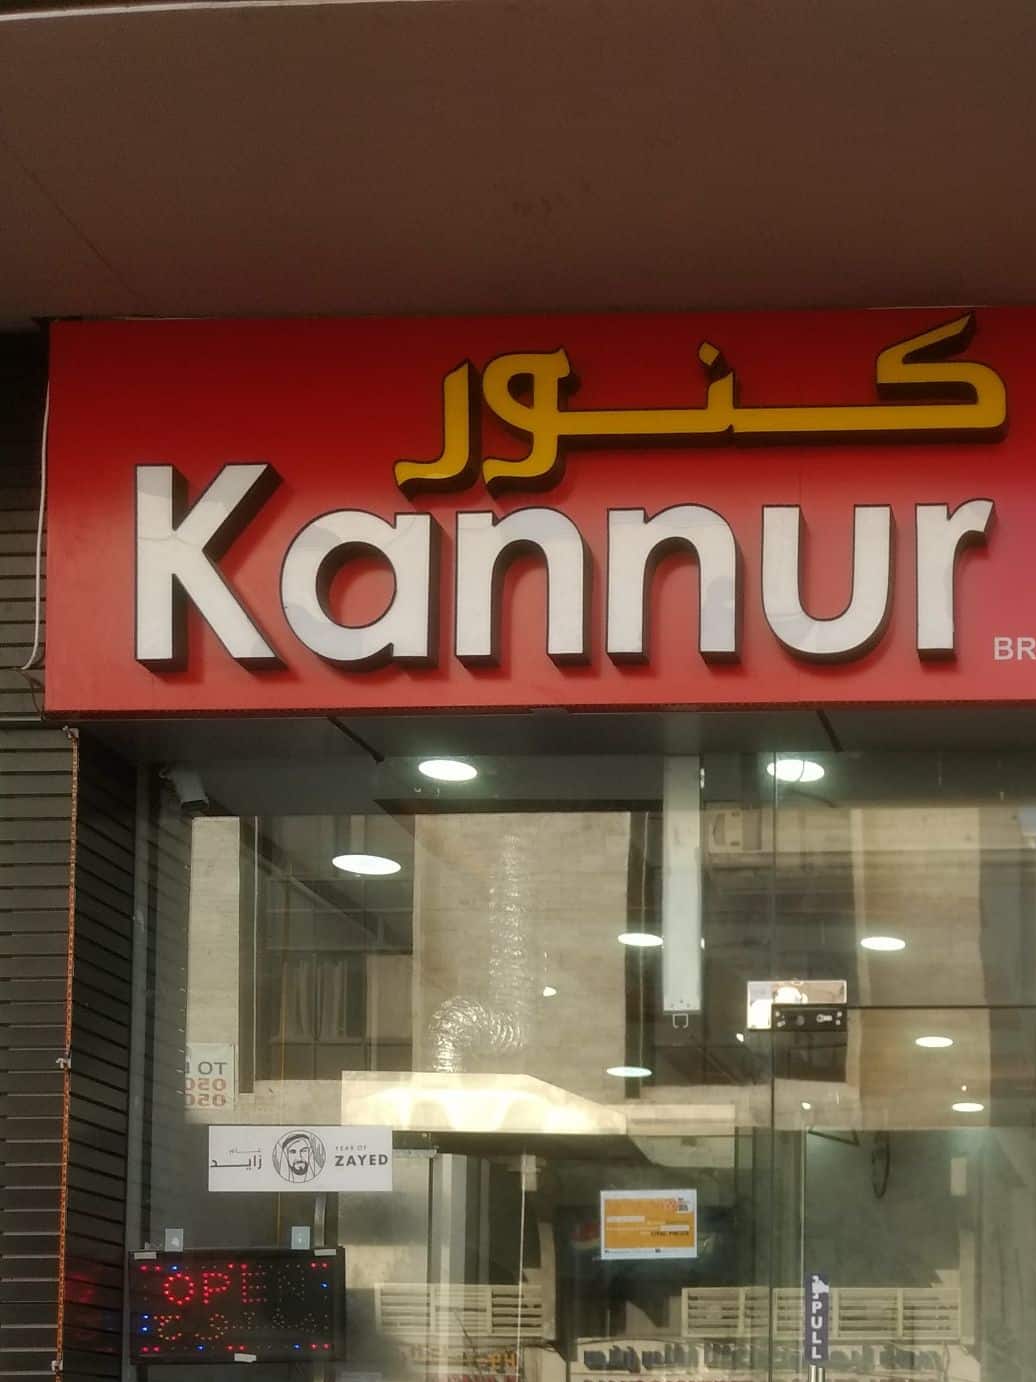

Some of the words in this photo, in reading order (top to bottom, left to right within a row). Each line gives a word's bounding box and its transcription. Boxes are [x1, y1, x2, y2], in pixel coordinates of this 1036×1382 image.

[393, 312, 1009, 492] كنور
[133, 461, 996, 667] Kannur
[335, 1154, 389, 1167] ZAYED
[810, 1300, 823, 1360] PULL
